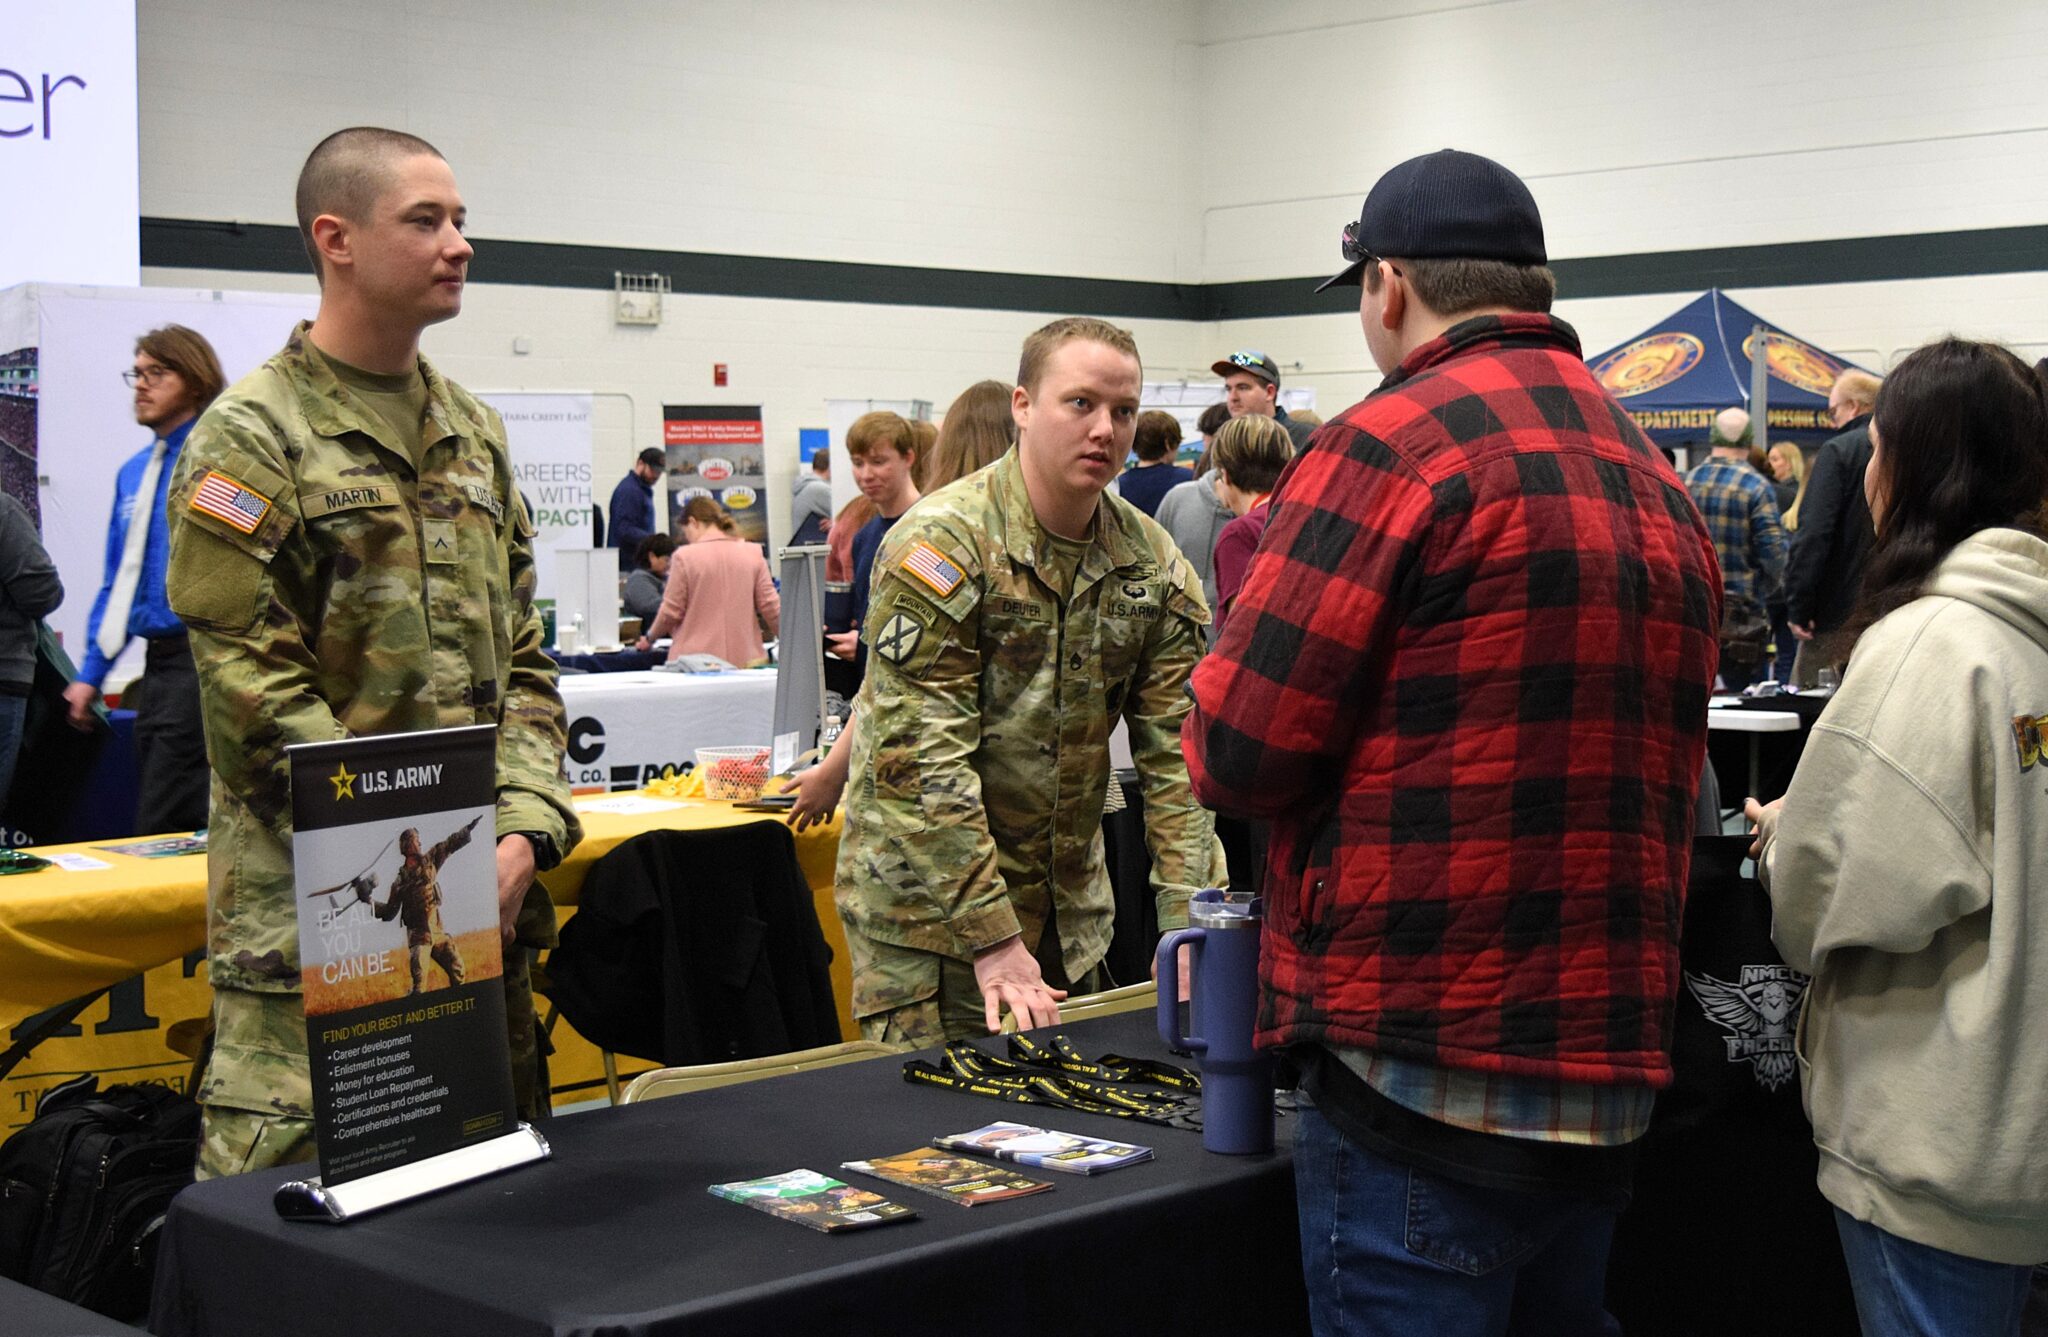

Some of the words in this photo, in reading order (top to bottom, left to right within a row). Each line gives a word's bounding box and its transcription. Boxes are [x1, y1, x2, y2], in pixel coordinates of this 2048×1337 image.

[512, 463, 592, 482] AREERS
[325, 488, 382, 509] MARTIN
[538, 486, 592, 504] WITH
[537, 508, 593, 527] PACT
[900, 596, 932, 621] MOUNTAIN
[1003, 601, 1041, 617] DEUTER
[362, 770, 392, 794] U.S.
[395, 763, 443, 790] ARMY
[581, 769, 606, 783] CO.
[318, 908, 345, 932] BE
[349, 900, 383, 925] ALL
[322, 929, 362, 958] YOU
[322, 957, 363, 984] CAN
[367, 950, 395, 976] BE.
[322, 1026, 349, 1044] FIND
[350, 1018, 378, 1037] YOUR
[378, 1014, 403, 1032] BEST
[405, 1009, 426, 1025] AND
[427, 1000, 463, 1019] BETTER
[333, 1046, 360, 1061] Career
[361, 1034, 412, 1055] development
[334, 1057, 376, 1077] Enlistment
[377, 1050, 410, 1066] bonuses
[335, 1077, 362, 1092] Money
[363, 1073, 375, 1086] for
[375, 1063, 415, 1082] education
[336, 1091, 368, 1109] Student
[369, 1087, 389, 1100] Loan
[390, 1074, 433, 1096] Repayment
[337, 1102, 390, 1125] Certifications
[391, 1097, 406, 1110] and
[406, 1086, 449, 1106] credentials
[338, 1116, 400, 1140] Comprehensive
[401, 1103, 442, 1123] healthcare
